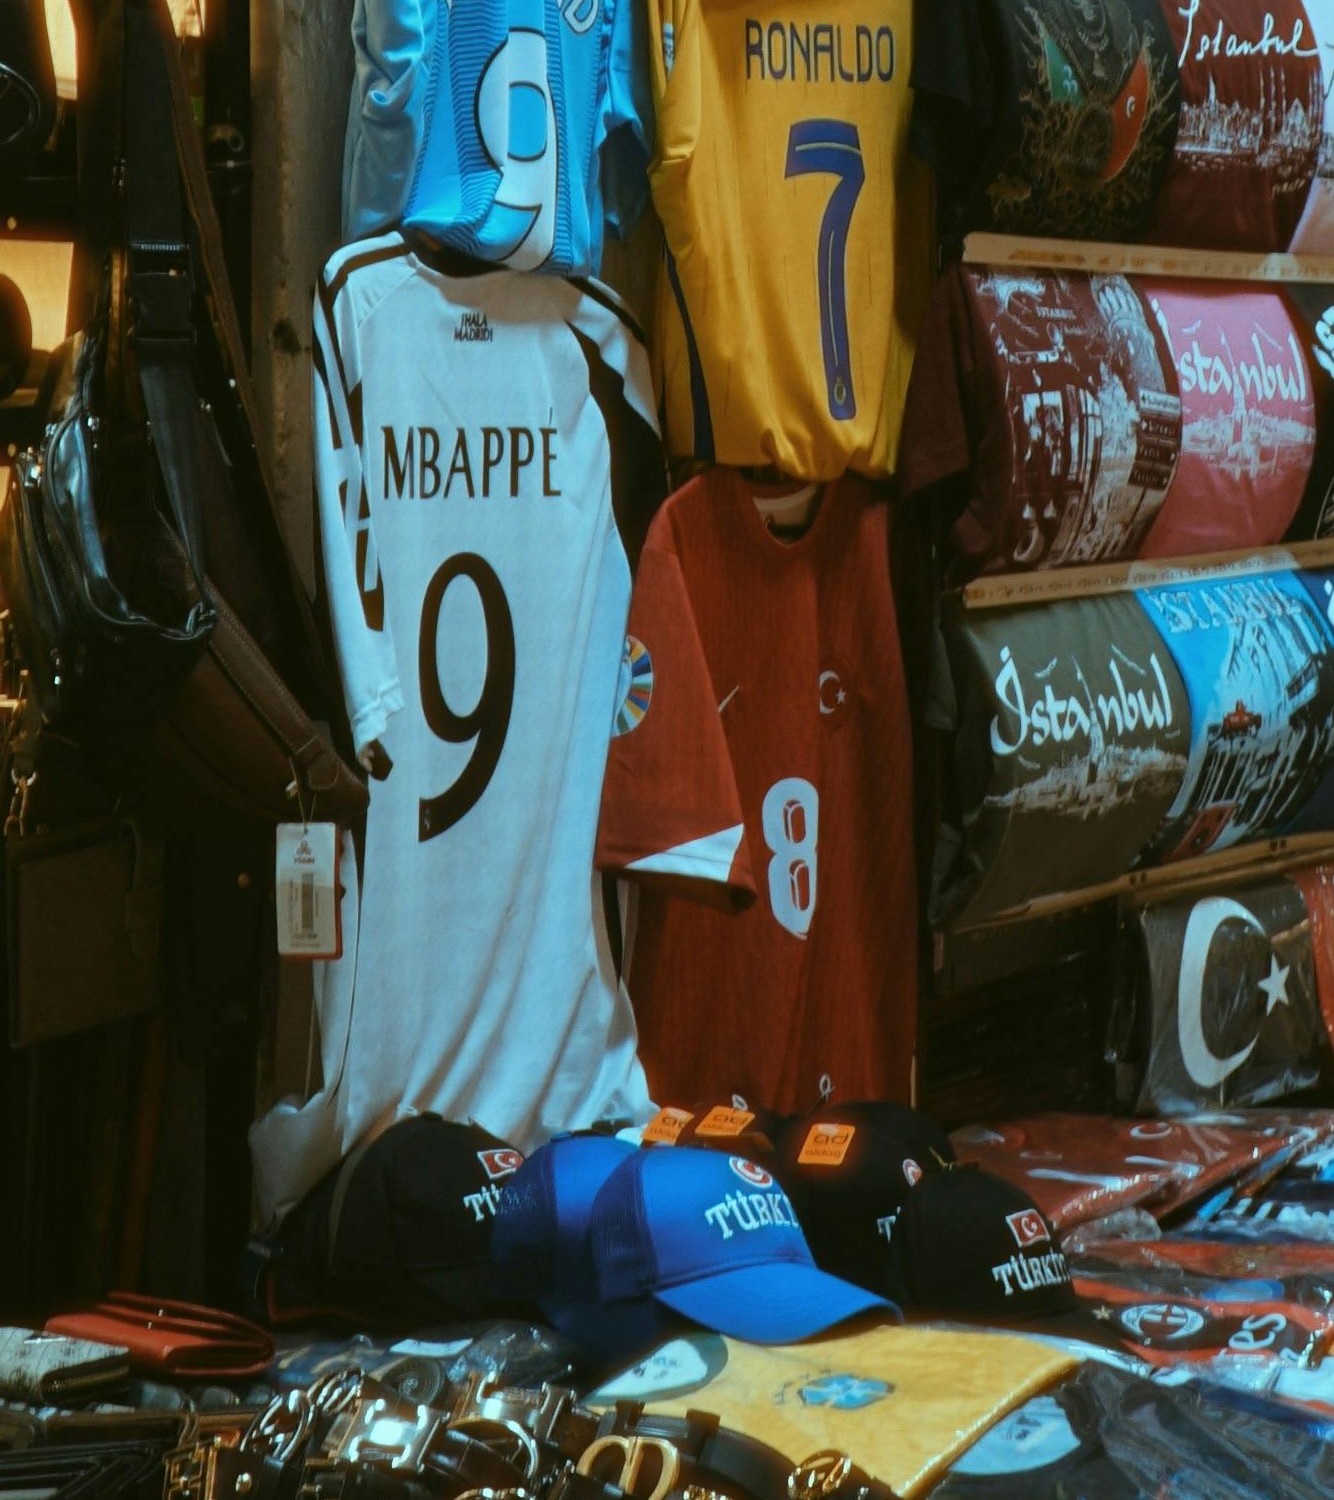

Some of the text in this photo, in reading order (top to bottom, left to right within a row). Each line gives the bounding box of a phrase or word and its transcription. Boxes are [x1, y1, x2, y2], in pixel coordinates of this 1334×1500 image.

[745, 18, 895, 84] RONALDO
[784, 117, 867, 421] 7
[380, 406, 562, 500] MBAPPÉ
[417, 550, 517, 844] 9
[761, 776, 820, 940] 8
